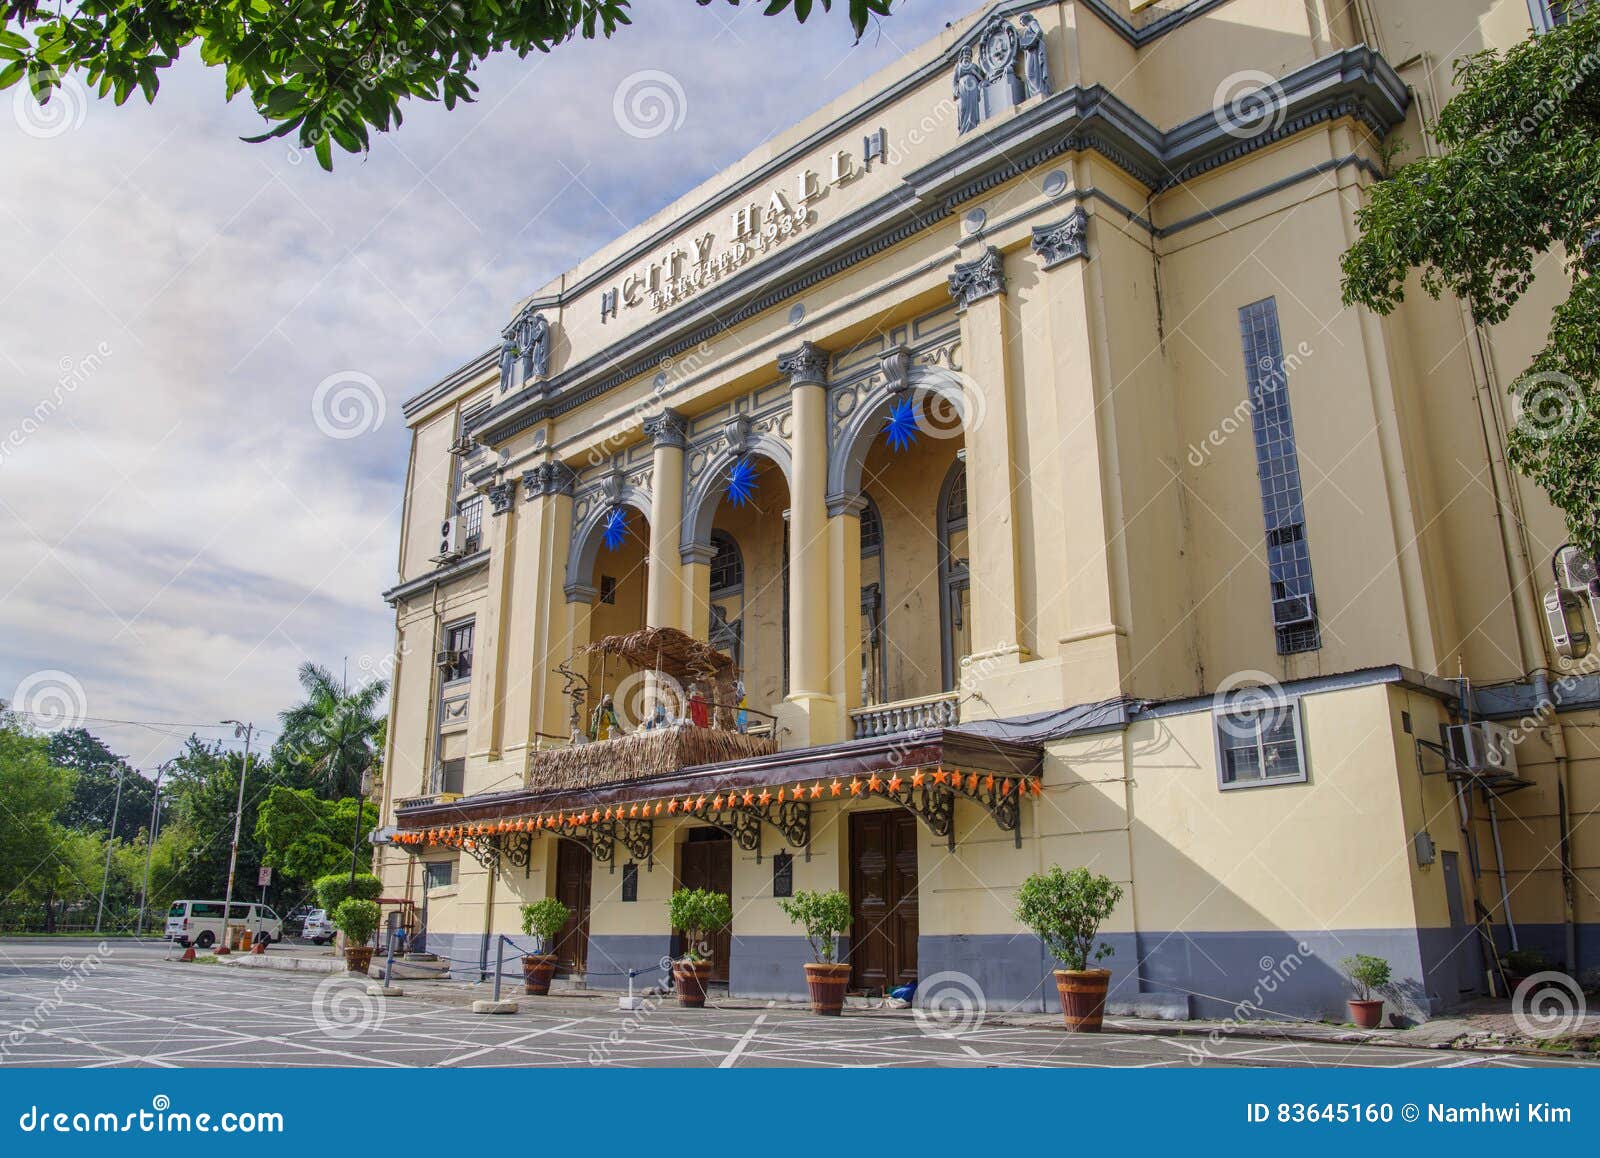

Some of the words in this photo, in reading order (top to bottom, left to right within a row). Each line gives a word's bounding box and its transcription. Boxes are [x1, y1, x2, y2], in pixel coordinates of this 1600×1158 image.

[620, 232, 715, 310] CITY
[730, 150, 852, 243] HALL
[649, 242, 746, 311] ERECTED
[750, 205, 808, 250] 1939
